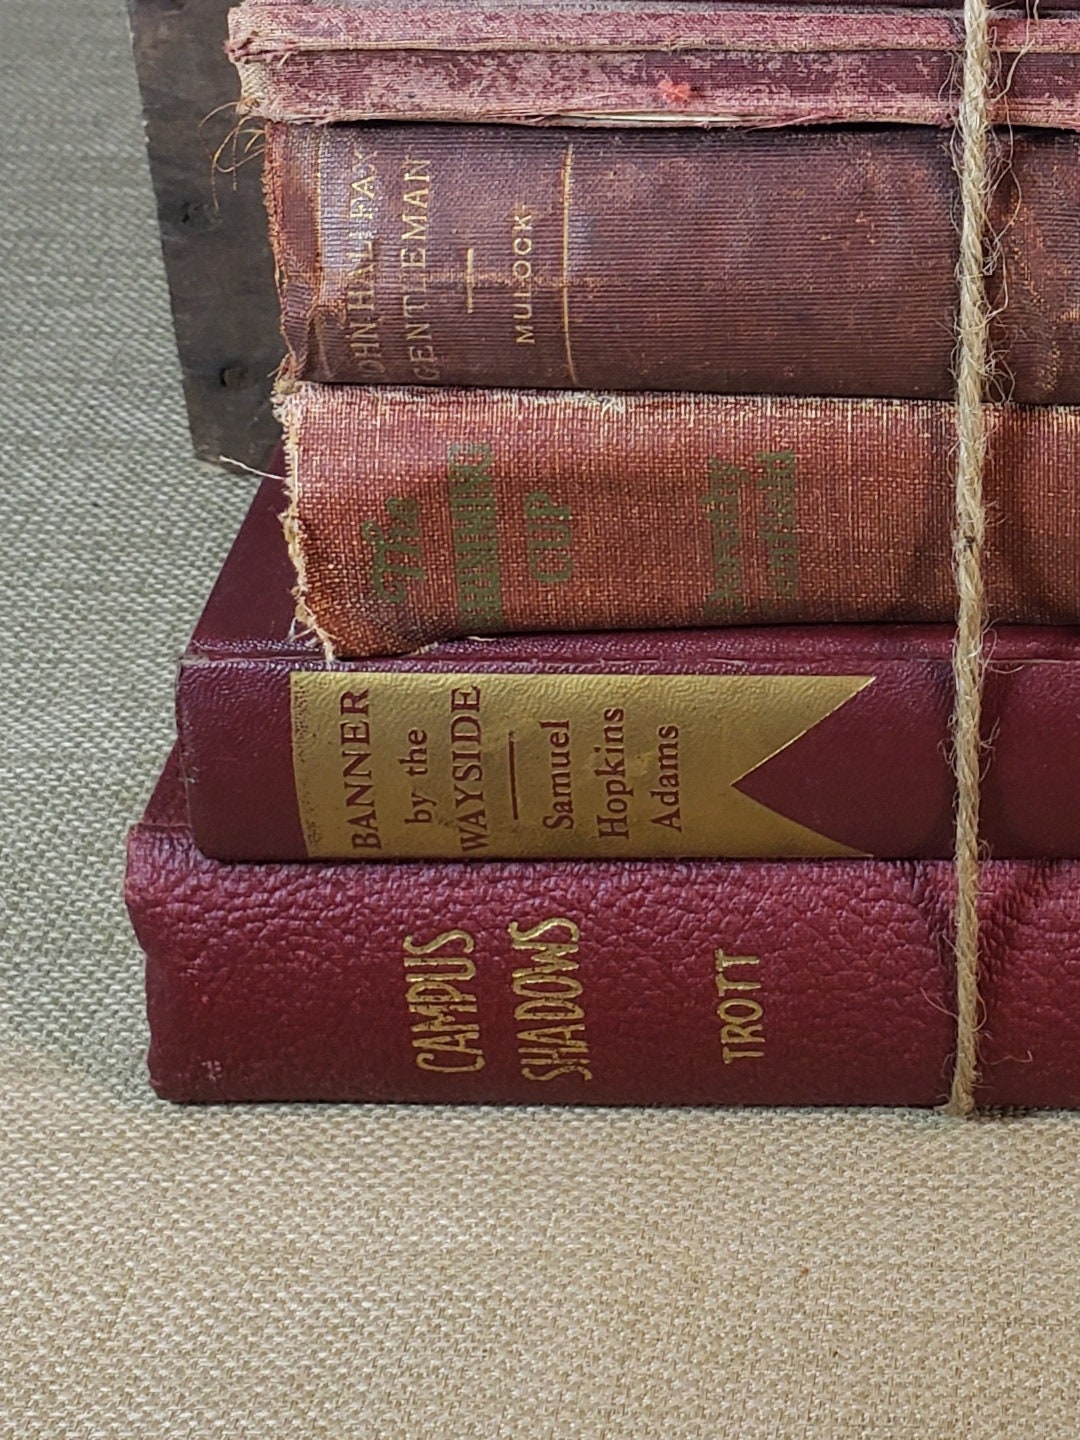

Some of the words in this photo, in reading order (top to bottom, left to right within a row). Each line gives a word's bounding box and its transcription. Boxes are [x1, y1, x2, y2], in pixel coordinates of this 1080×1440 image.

[512, 212, 535, 345] MULOCK
[524, 489, 574, 584] CUP
[340, 687, 382, 851] BANNER
[404, 727, 428, 778] the
[406, 790, 438, 825] by
[450, 685, 490, 854] WAYSIDE
[539, 718, 575, 831] Samuel
[597, 706, 634, 840] Hopkins
[651, 724, 683, 833] Adams
[403, 928, 486, 1075] CAMPUS
[508, 917, 593, 1083] SHADOWS
[714, 948, 766, 1065] TROTT
